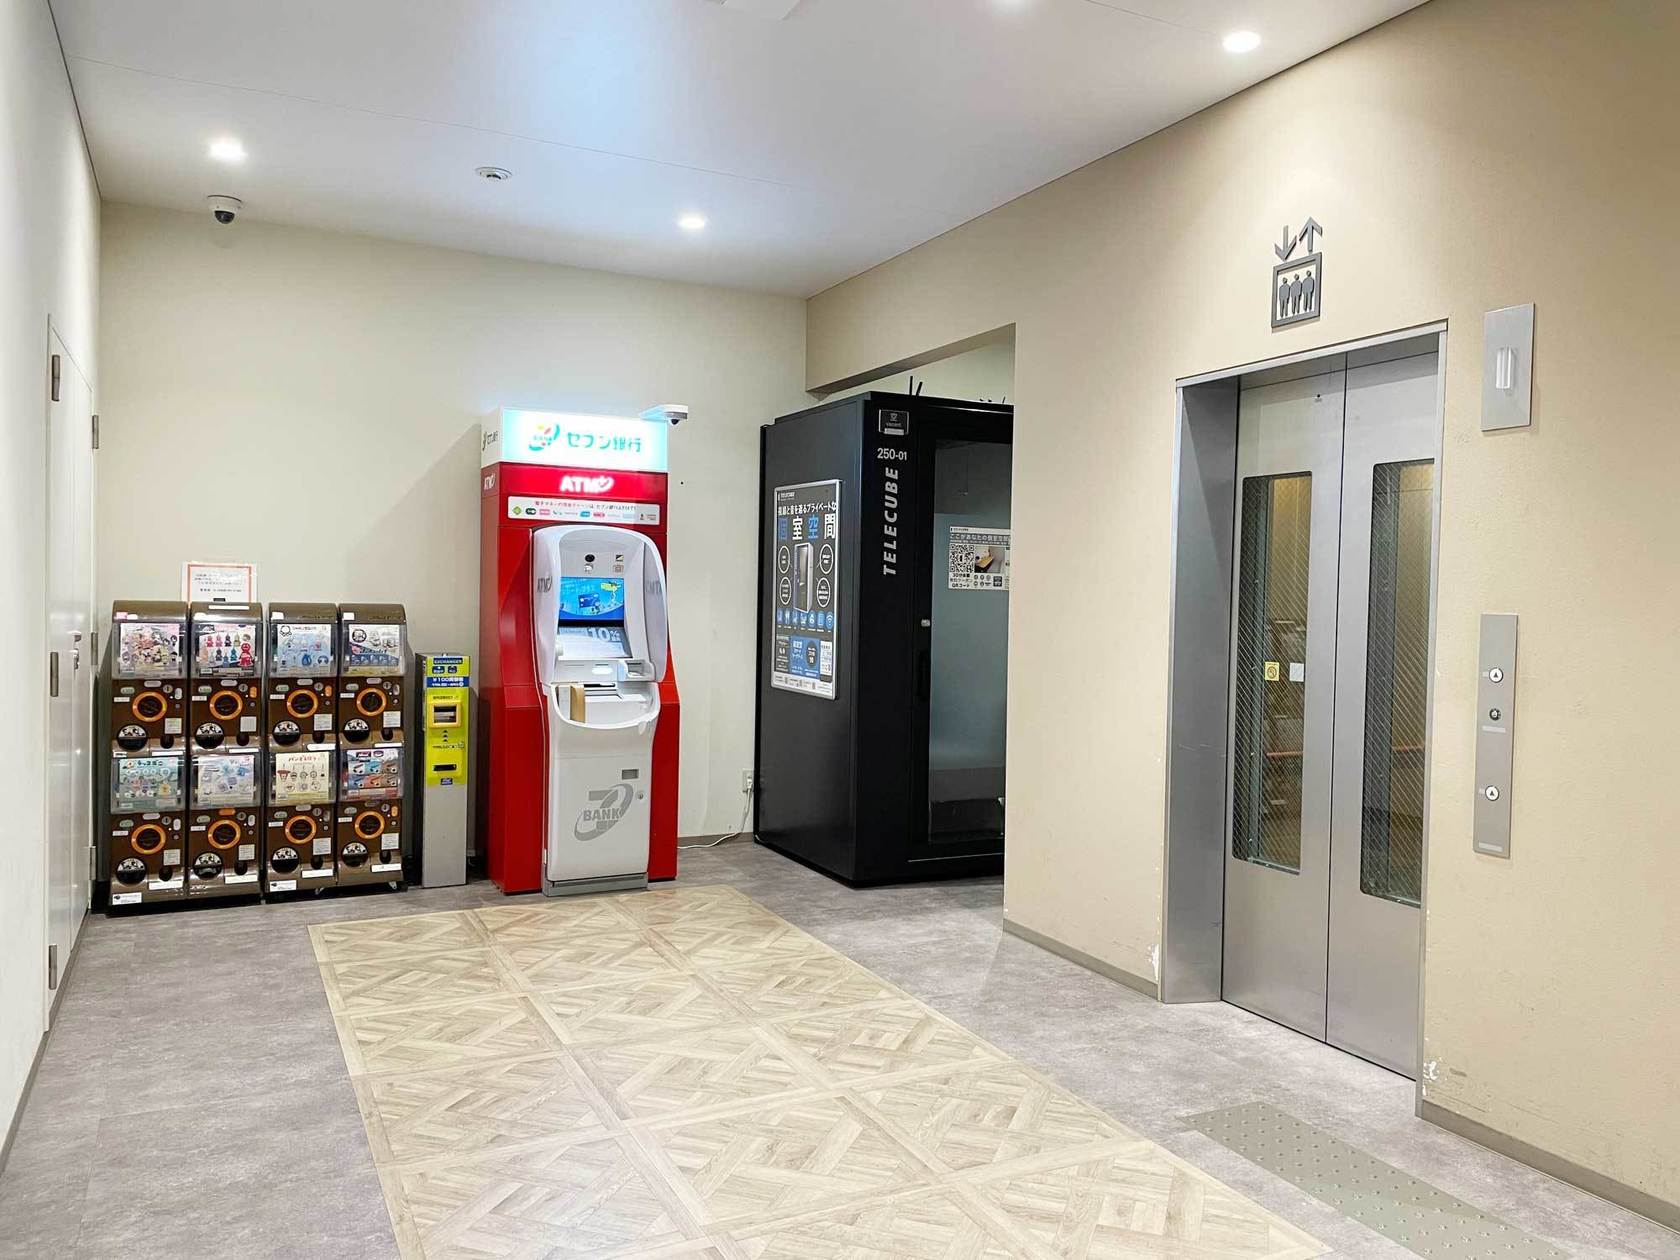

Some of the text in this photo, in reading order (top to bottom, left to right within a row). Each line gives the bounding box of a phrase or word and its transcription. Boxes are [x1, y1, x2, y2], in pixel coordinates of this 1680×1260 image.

[877, 447, 908, 461] 250-01
[883, 467, 899, 576] TELECUBE
[583, 808, 619, 821] BANK
